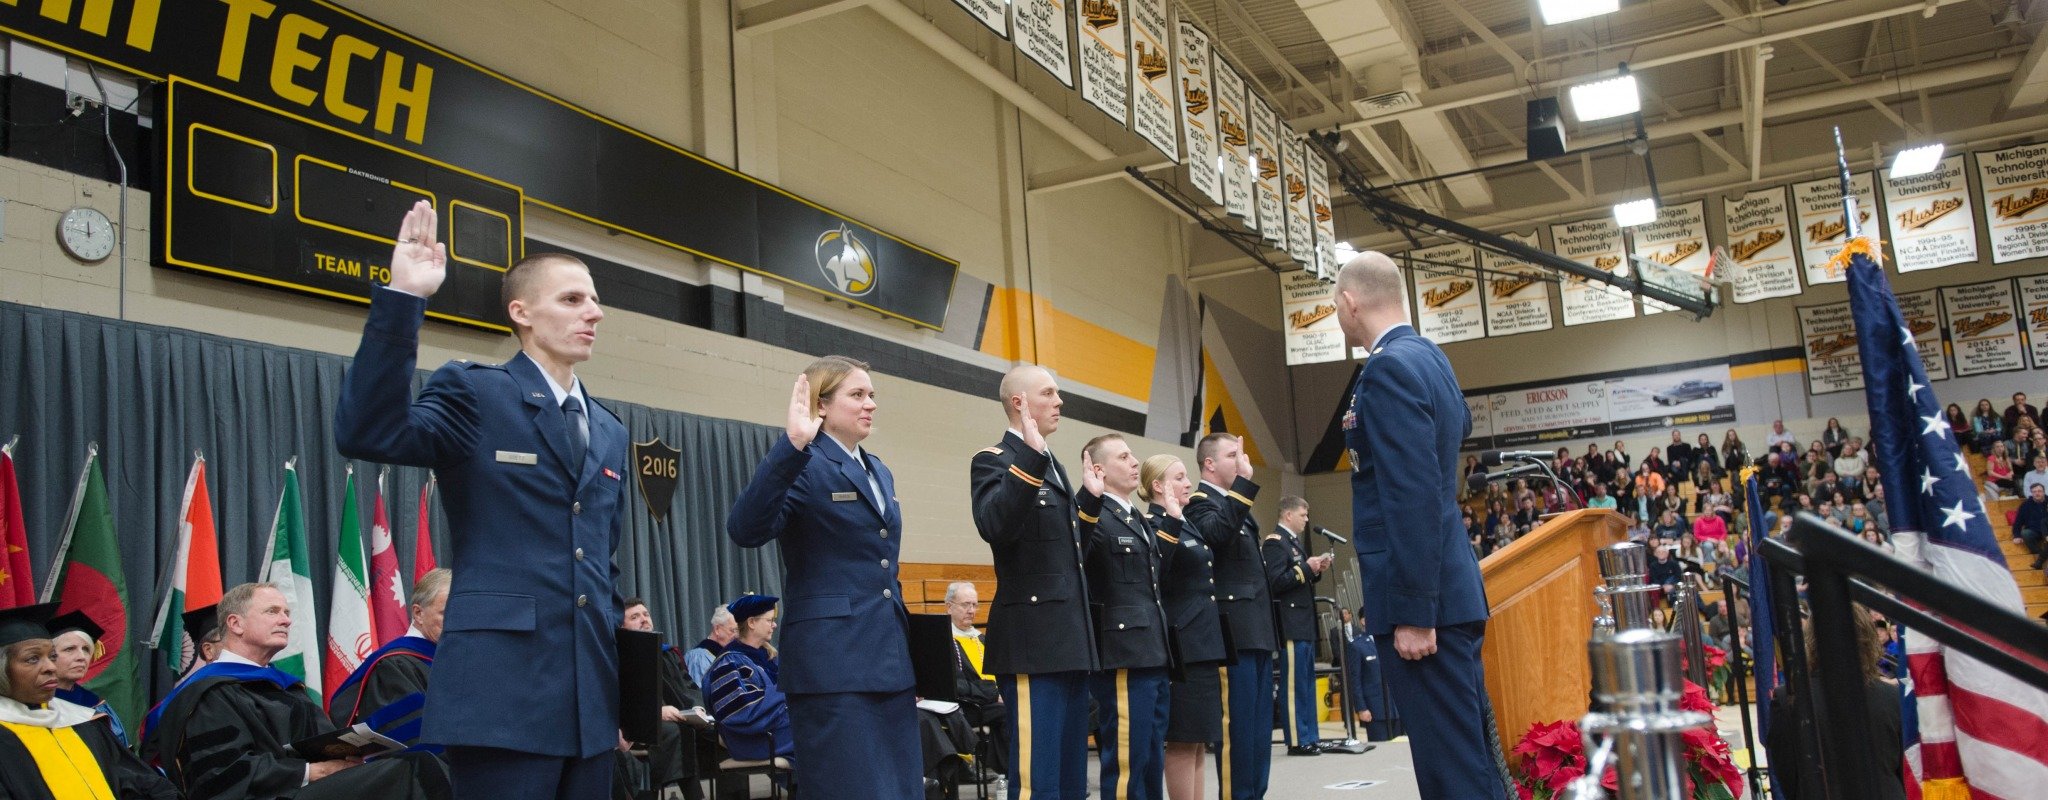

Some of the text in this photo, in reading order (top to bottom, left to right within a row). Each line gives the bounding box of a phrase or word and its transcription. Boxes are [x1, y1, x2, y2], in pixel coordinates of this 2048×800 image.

[1028, 39, 1058, 71] Champions
[216, 0, 434, 144] TECH
[1995, 148, 2047, 162] Michigan
[1984, 158, 2048, 175] Technologi
[348, 167, 390, 184] DAKTRONICS
[1887, 168, 1961, 188] Technological
[1898, 181, 1951, 196] University
[1657, 207, 1688, 219] chigan
[1896, 197, 1964, 230] Huskies
[1567, 222, 1607, 234] Michigan
[1637, 215, 1701, 232] Technological
[1733, 218, 1775, 232] University
[1558, 229, 1620, 245] Technological
[1646, 228, 1692, 241] University
[2004, 235, 2026, 243] NCAA
[1567, 242, 1612, 255] University
[1730, 230, 1785, 262] Huskies
[1930, 241, 1957, 251] Division
[1997, 241, 2029, 251] Regional
[1424, 248, 1461, 260] Michigan
[1905, 246, 1969, 261] Regional Finalist
[1937, 252, 1975, 262] Basketball
[314, 253, 392, 284] TEAM FO
[1291, 288, 1329, 299] University
[1422, 280, 1474, 307] Huskies
[1949, 290, 2008, 302] Technological
[1957, 285, 1996, 294] Michigan
[1812, 306, 1848, 315] Michigan
[1958, 300, 2001, 309] University
[1953, 312, 2012, 334] Huskies
[1526, 388, 1569, 404] ERICKSON
[1524, 407, 1544, 415] SEED
[1555, 403, 1570, 411] PET
[1572, 401, 1600, 409] SUPPLY
[642, 455, 677, 479] 2016
